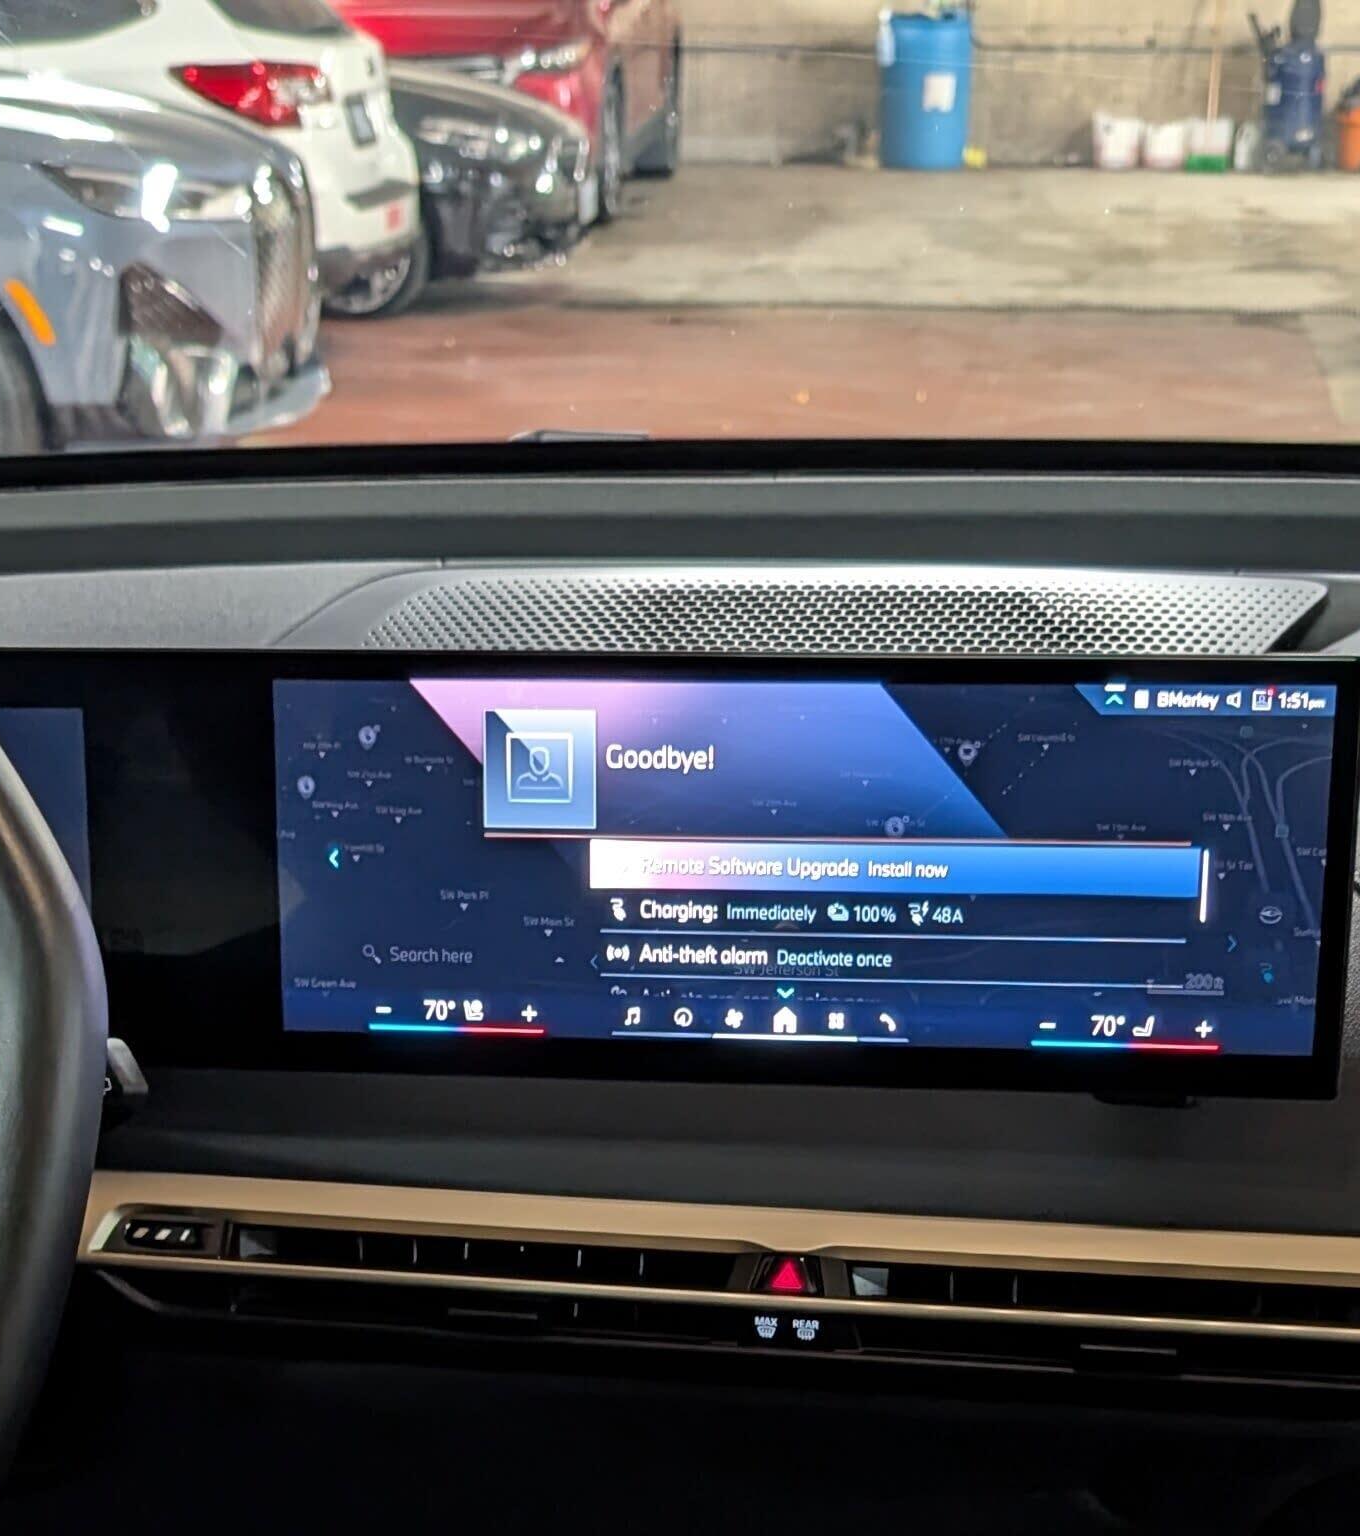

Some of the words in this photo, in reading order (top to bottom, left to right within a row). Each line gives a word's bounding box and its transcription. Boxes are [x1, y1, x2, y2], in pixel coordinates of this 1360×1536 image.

[605, 743, 715, 775] Goodbye!
[708, 855, 782, 877] Software
[787, 856, 859, 881] Upgrade
[867, 860, 911, 878] Install
[915, 864, 949, 879] now
[640, 898, 718, 924] Charging:
[727, 904, 816, 925] Immediately
[853, 906, 896, 923] 100%
[932, 907, 964, 924] 48A
[389, 946, 438, 963] Search
[441, 947, 474, 965] here
[639, 943, 718, 966] Anti-theft
[720, 947, 768, 966] alarm
[777, 949, 854, 968] Deactivate
[856, 954, 893, 968] once
[754, 1315, 778, 1327] MAX
[792, 1319, 820, 1330] REAR
